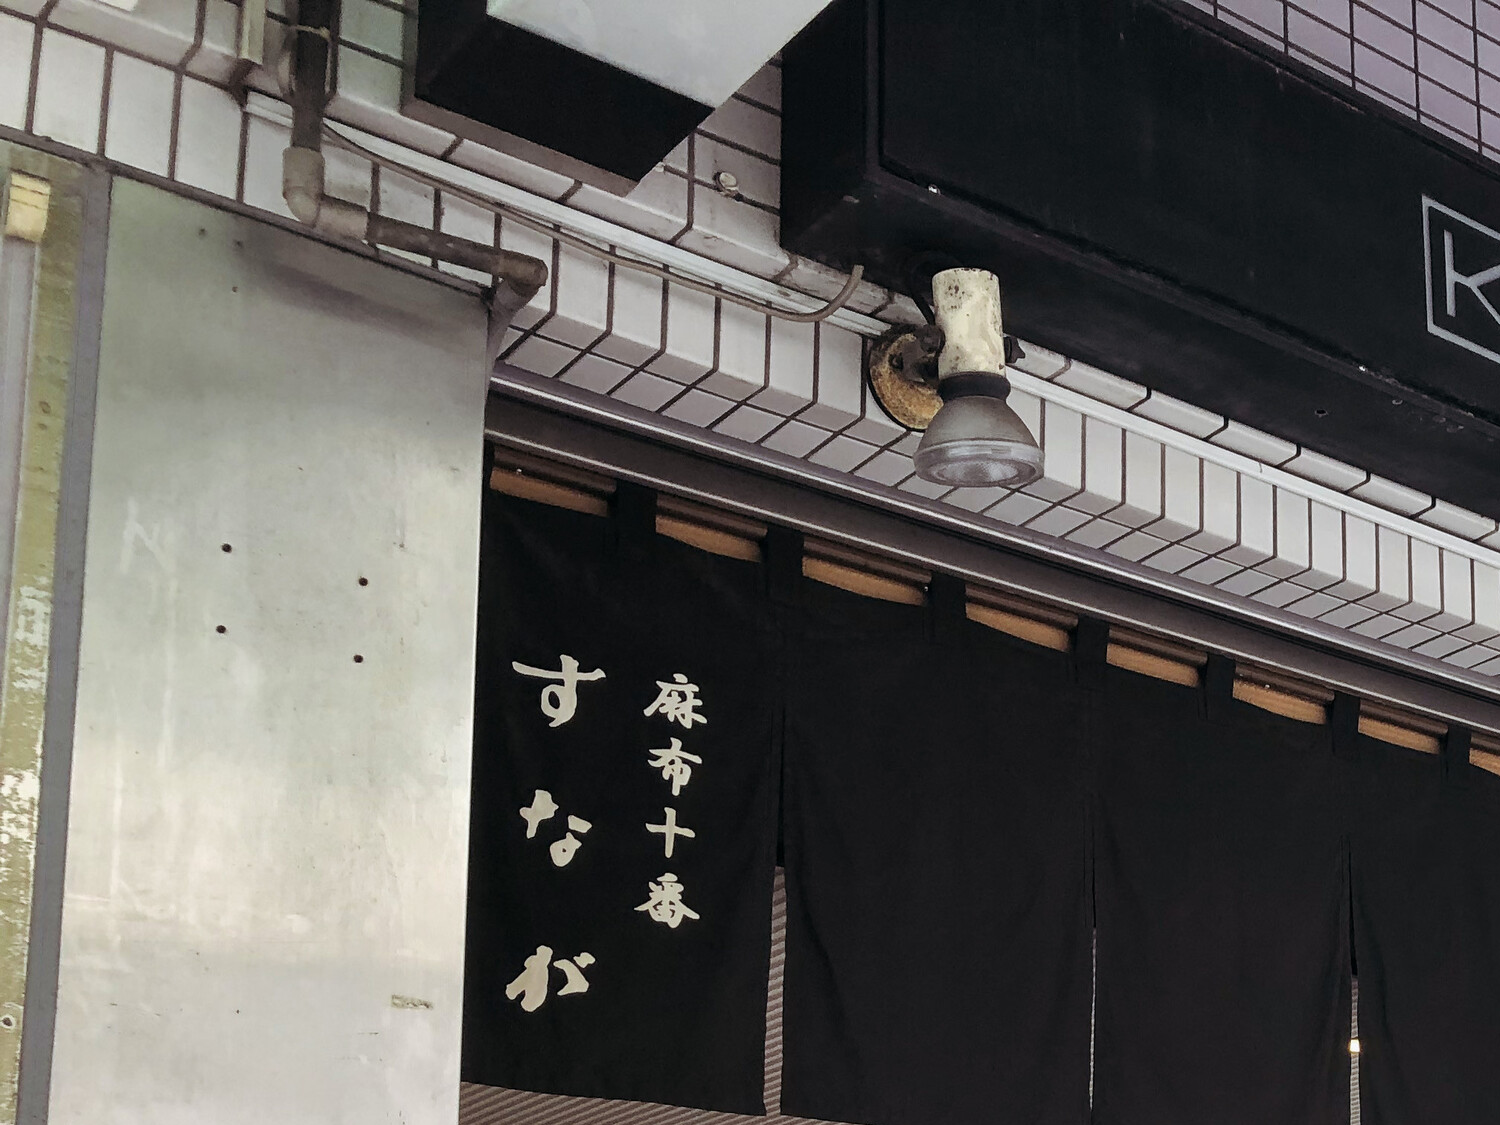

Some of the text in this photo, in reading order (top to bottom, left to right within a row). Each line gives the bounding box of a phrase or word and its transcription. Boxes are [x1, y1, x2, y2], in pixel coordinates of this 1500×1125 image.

[505, 654, 607, 1013] すなが
[634, 673, 708, 929] 麻布十番
